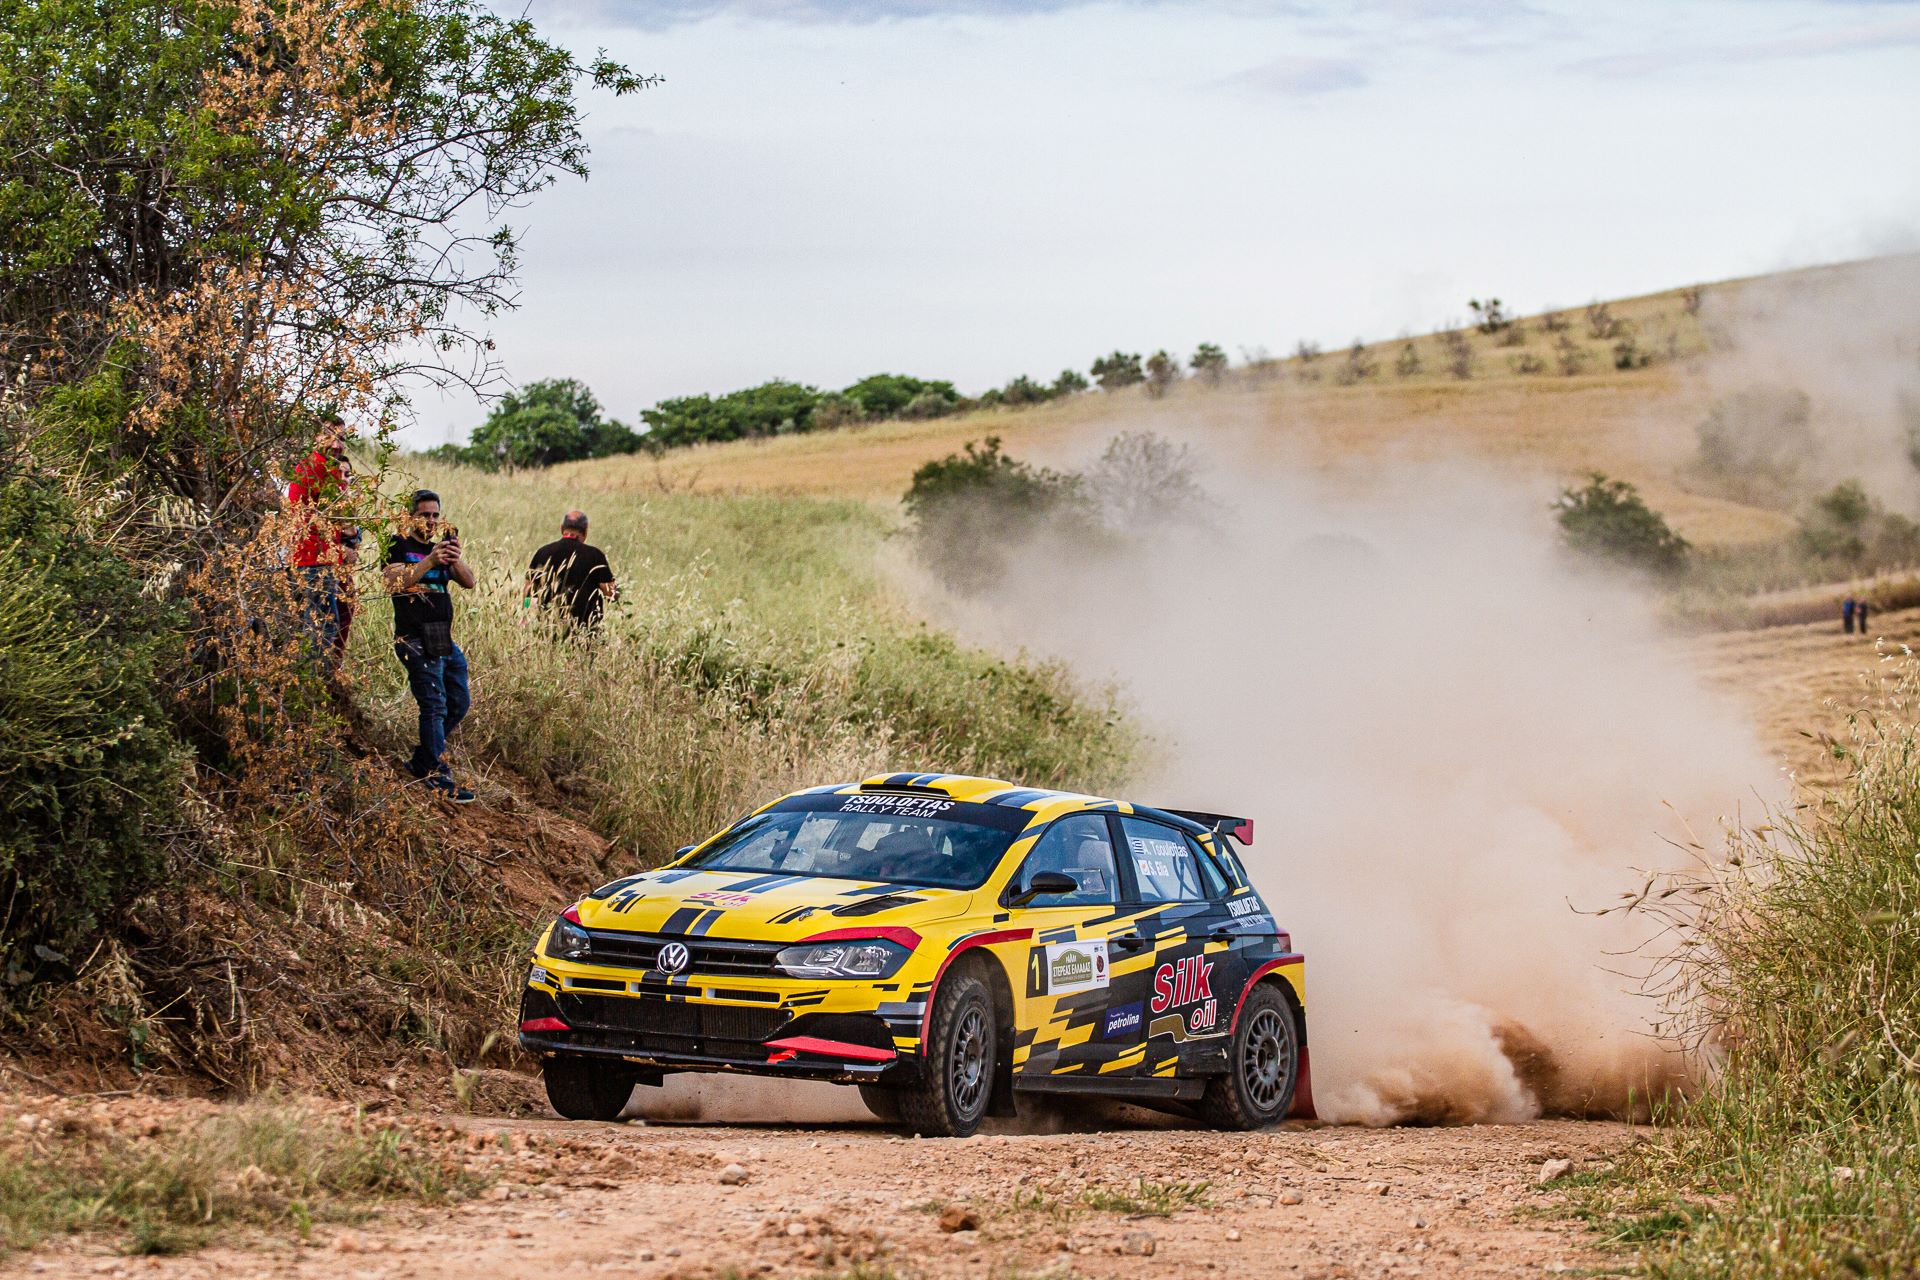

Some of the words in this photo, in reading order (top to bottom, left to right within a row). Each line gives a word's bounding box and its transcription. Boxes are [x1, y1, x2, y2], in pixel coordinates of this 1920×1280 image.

[839, 803, 891, 813] RALLY
[892, 806, 937, 818] TEAM
[844, 795, 955, 811] TSOULOFTAS
[1031, 953, 1040, 991] 1
[1151, 954, 1214, 1013] Silk
[1107, 1013, 1140, 1033] petrolina
[1190, 999, 1217, 1030] oil
